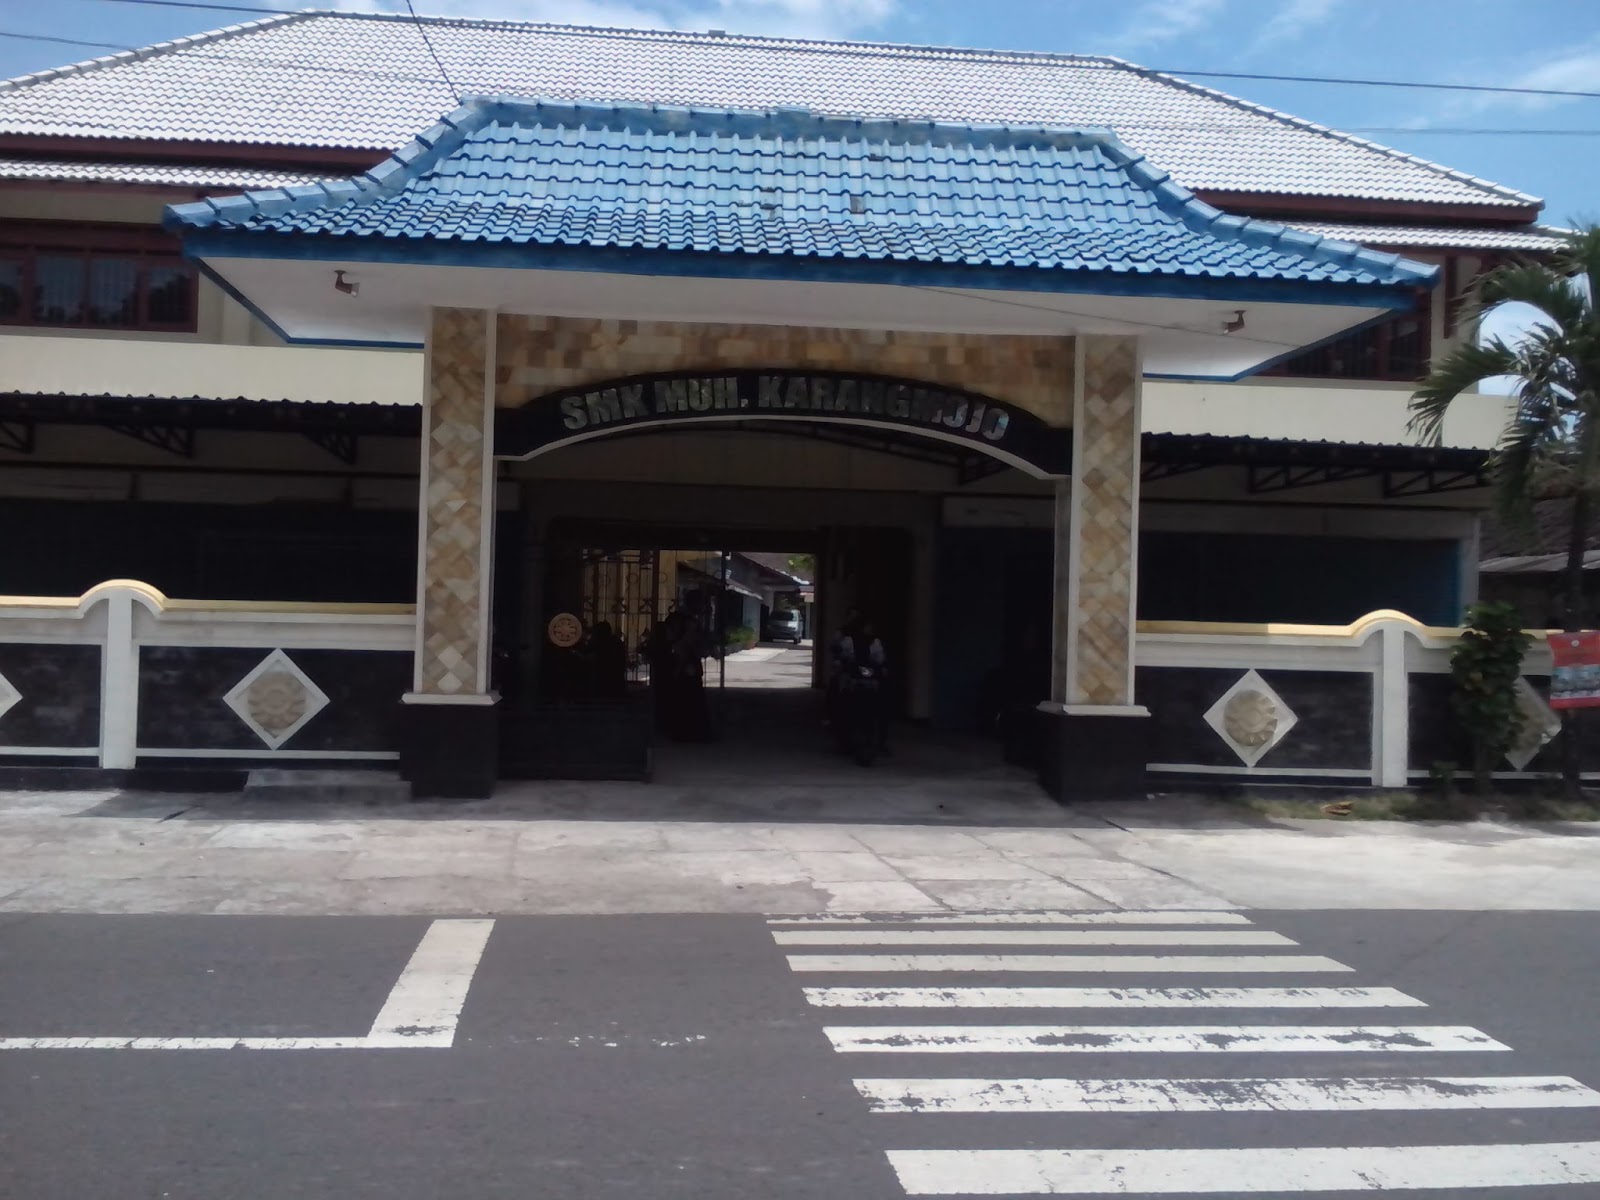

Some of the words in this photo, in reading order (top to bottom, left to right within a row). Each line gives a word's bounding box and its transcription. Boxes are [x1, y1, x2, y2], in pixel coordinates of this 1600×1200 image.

[560, 384, 648, 430] SMK
[654, 376, 749, 413] MUH.
[758, 375, 1010, 441] KARANGMOJO
